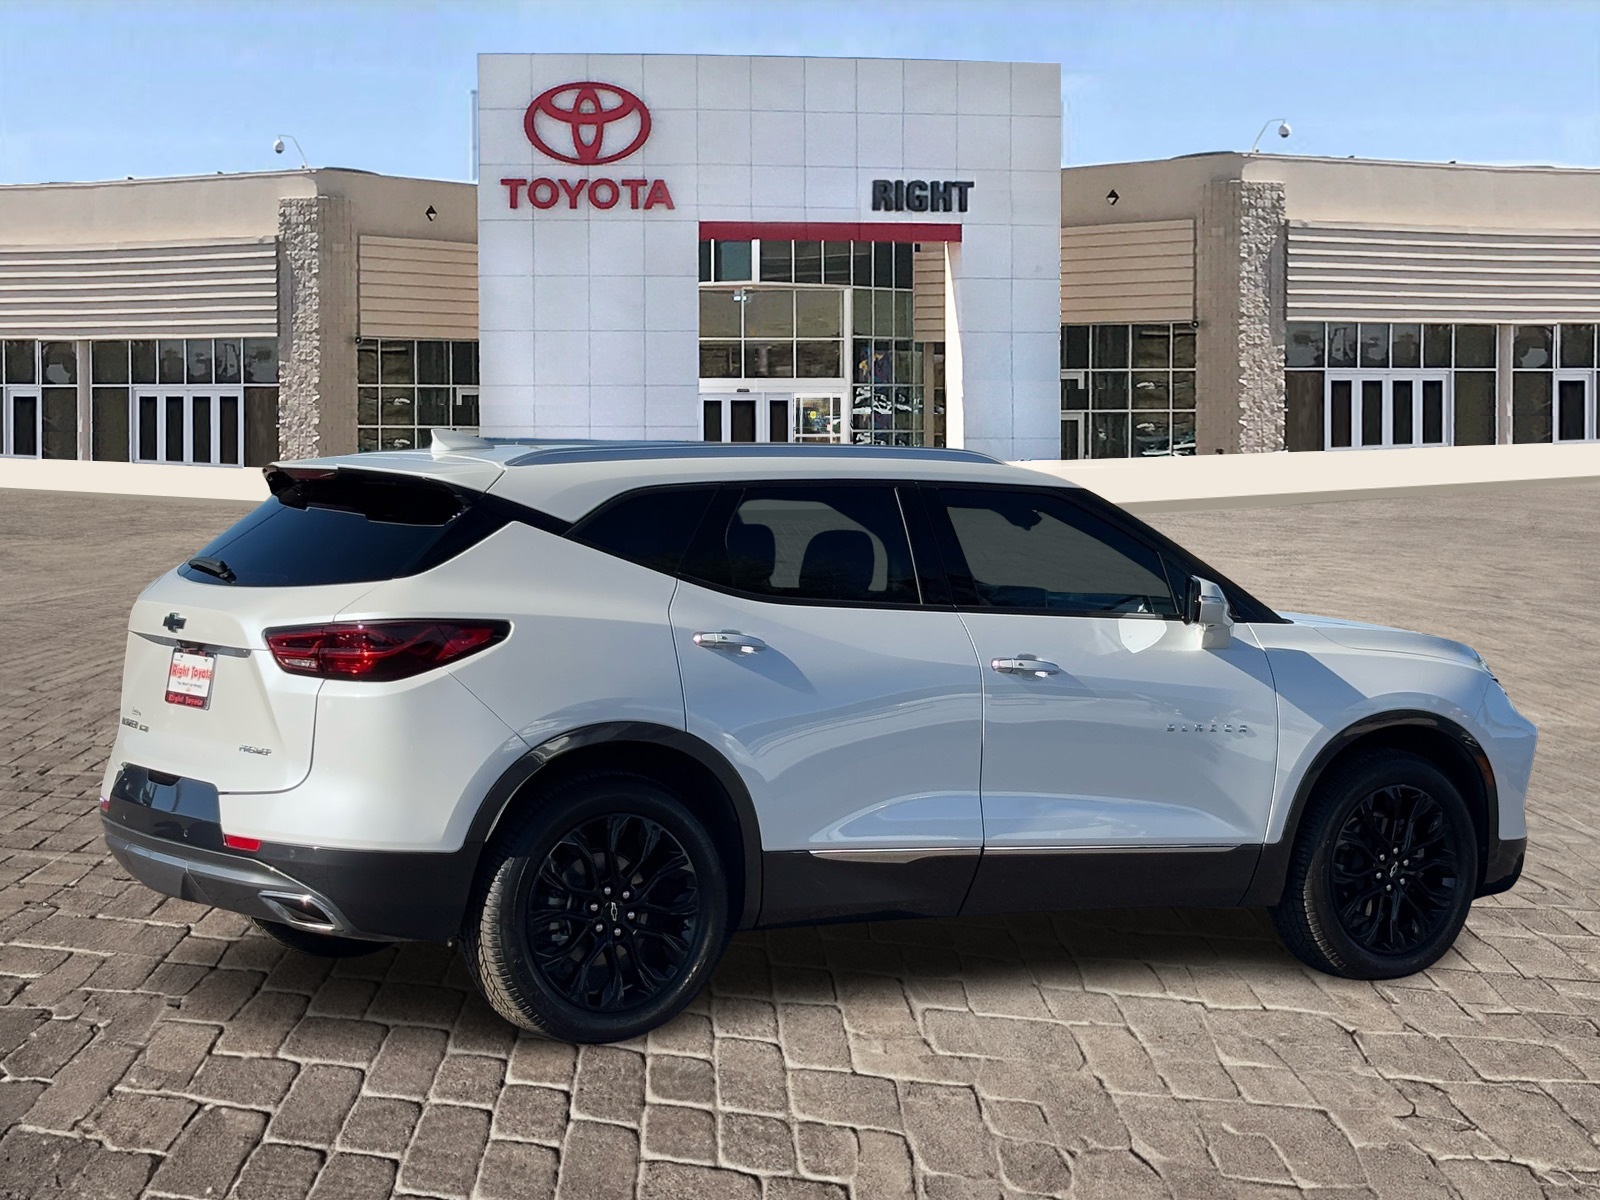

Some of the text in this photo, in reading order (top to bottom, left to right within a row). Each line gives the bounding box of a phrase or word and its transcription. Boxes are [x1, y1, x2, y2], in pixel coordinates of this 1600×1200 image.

[501, 178, 675, 210] TOYOTA
[872, 180, 975, 212] RIGHT
[171, 663, 212, 681] Right Toyota
[168, 693, 204, 706] Right Toyota
